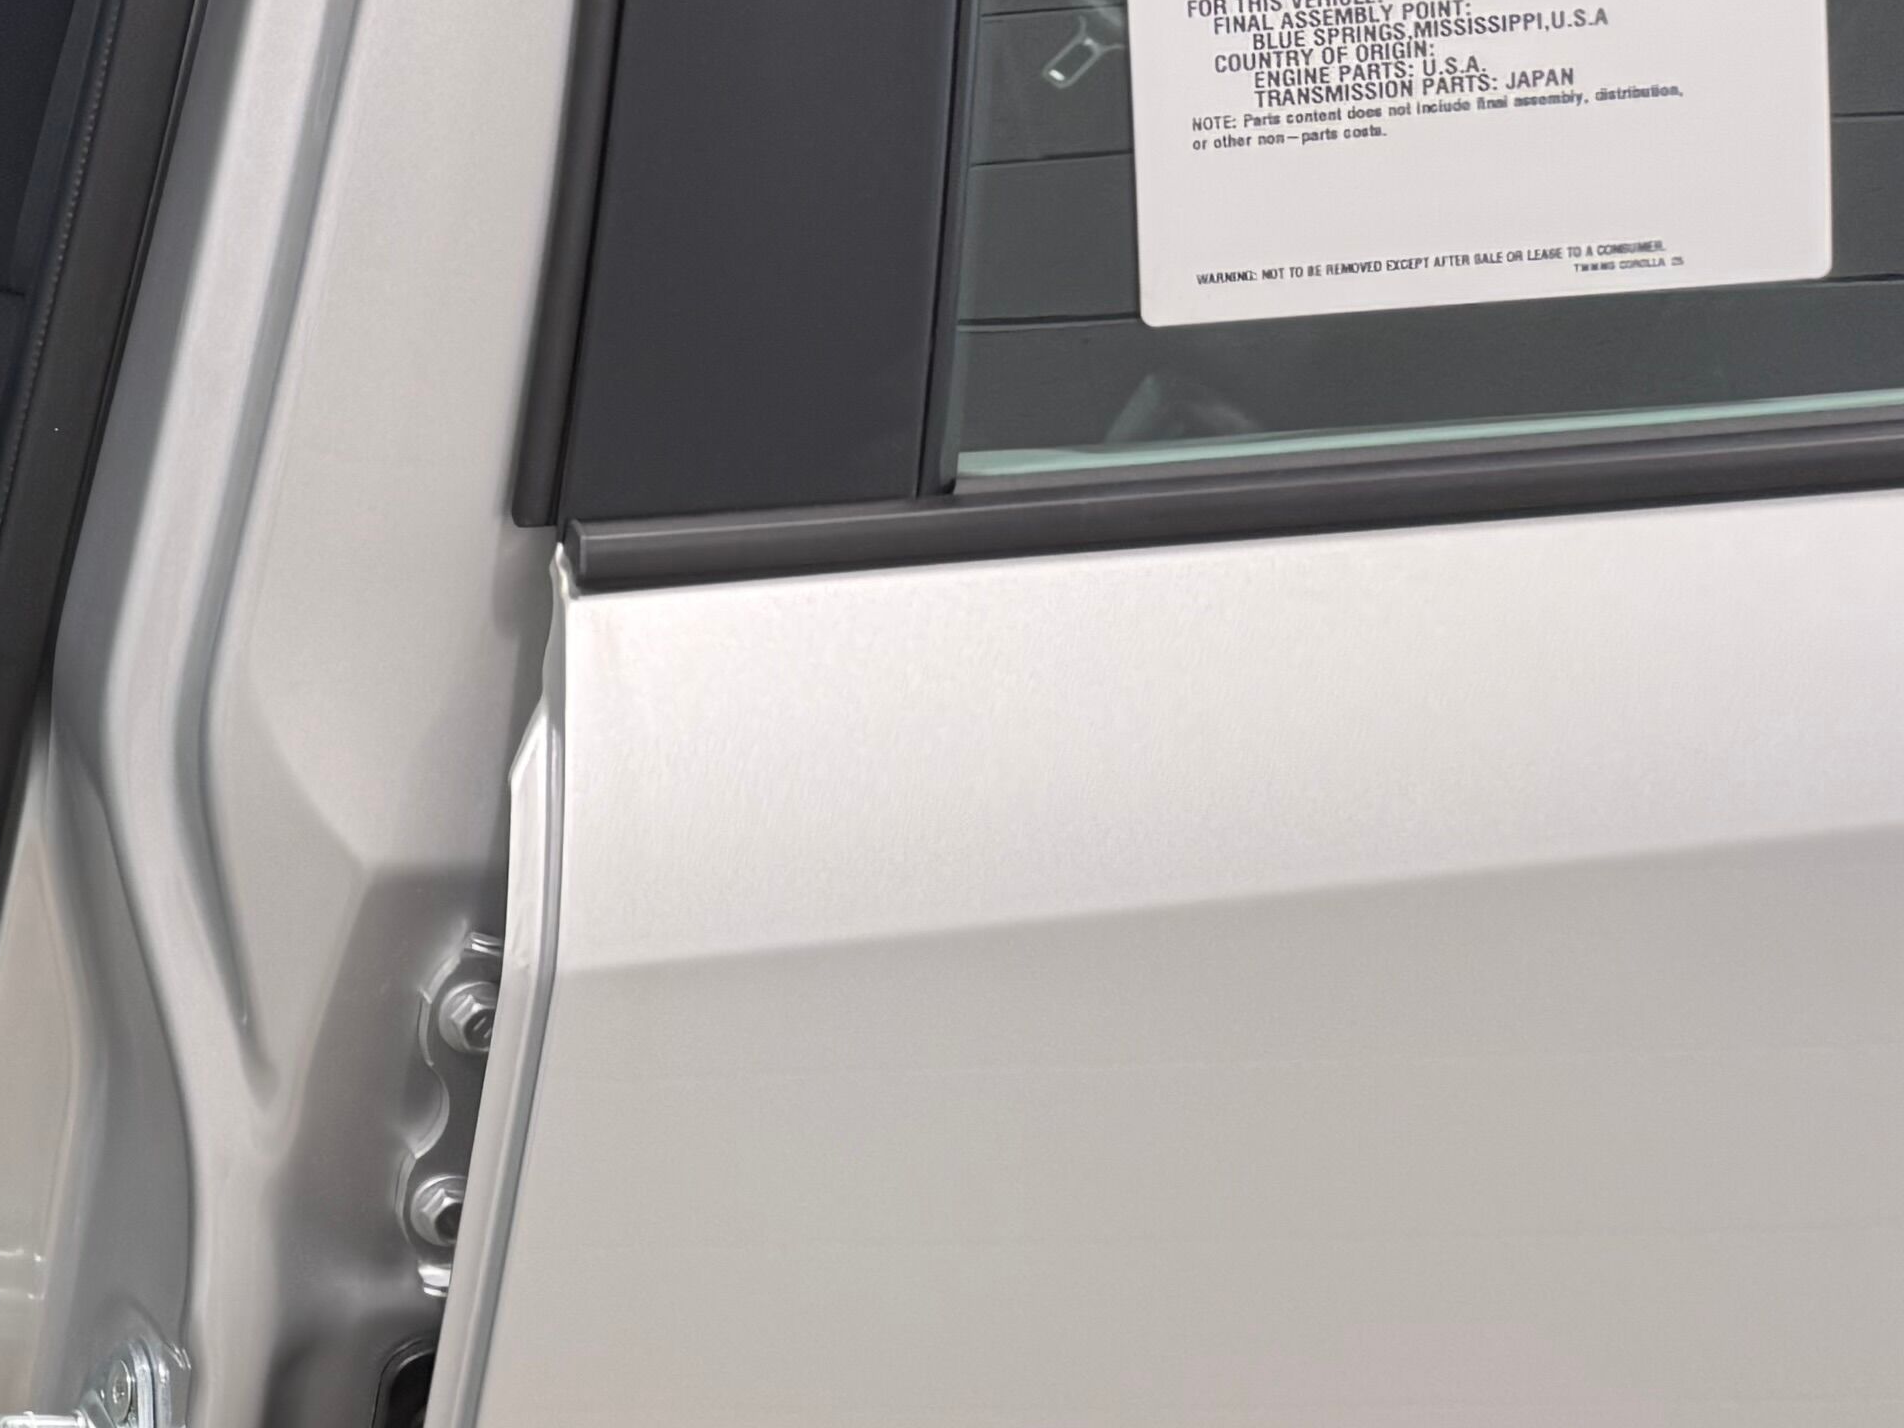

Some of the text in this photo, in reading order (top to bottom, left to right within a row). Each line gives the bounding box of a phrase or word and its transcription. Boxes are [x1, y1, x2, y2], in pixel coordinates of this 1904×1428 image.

[1213, 13, 1274, 35] FINAL
[1280, 3, 1393, 30] ASSEMBLY
[1252, 29, 1305, 50] BLUE
[1214, 40, 1434, 73] COUNTRY OF ORIGIN:
[1254, 55, 1486, 89] ENGINE PARTS: U.S.A.
[1253, 67, 1574, 108] TRANSMISSION PARTS: JAPAN
[1192, 114, 1237, 131] NOTE:
[1243, 113, 1281, 128] Parts
[1286, 107, 1342, 124] content
[1347, 105, 1382, 120] does
[1388, 102, 1412, 116] not
[1476, 95, 1508, 110] final
[1192, 139, 1208, 151] or
[1213, 133, 1252, 149] other
[1343, 124, 1387, 139] costs.
[1261, 267, 1284, 280] NOT
[1289, 266, 1304, 278] TO
[1326, 260, 1382, 275] REMOVED
[1386, 256, 1429, 271] EXCEPT
[1433, 254, 1470, 267] AFTER
[1506, 250, 1523, 263] OR
[1526, 247, 1562, 261] LEASE
[1567, 246, 1582, 258] TO
[1585, 245, 1593, 256] A
